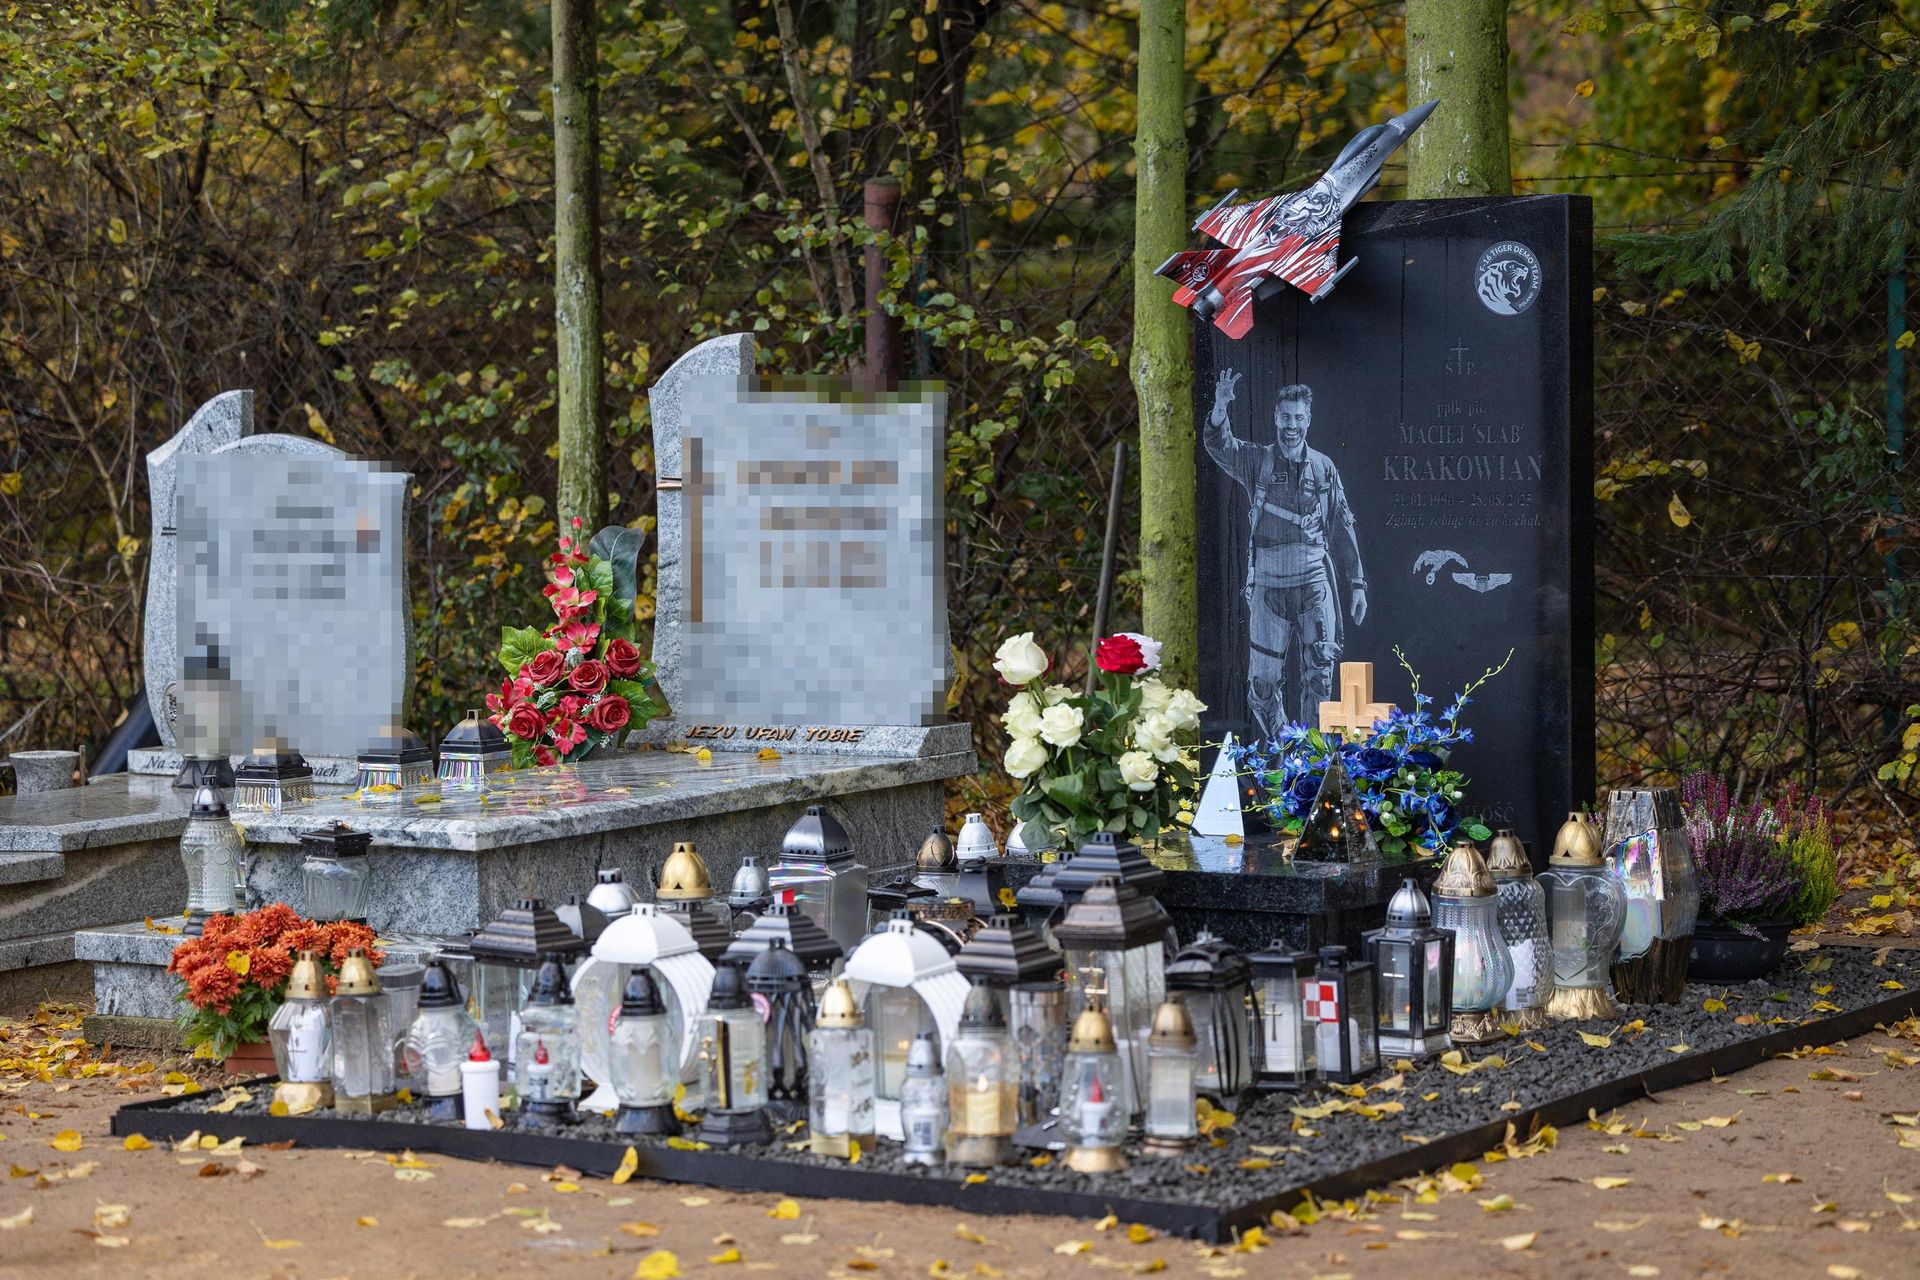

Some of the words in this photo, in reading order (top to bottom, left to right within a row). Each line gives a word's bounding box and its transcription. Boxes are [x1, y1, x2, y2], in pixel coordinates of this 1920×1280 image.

[1490, 245, 1513, 257] TIGER
[1513, 245, 1534, 264] DEMO
[1530, 262, 1539, 289] TEAM
[1400, 424, 1466, 444] MACIEJ
[1382, 454, 1544, 481] KRAKOWIAN
[745, 726, 797, 741] UFAM
[805, 727, 865, 742] TOBIE
[143, 756, 164, 770] Na
